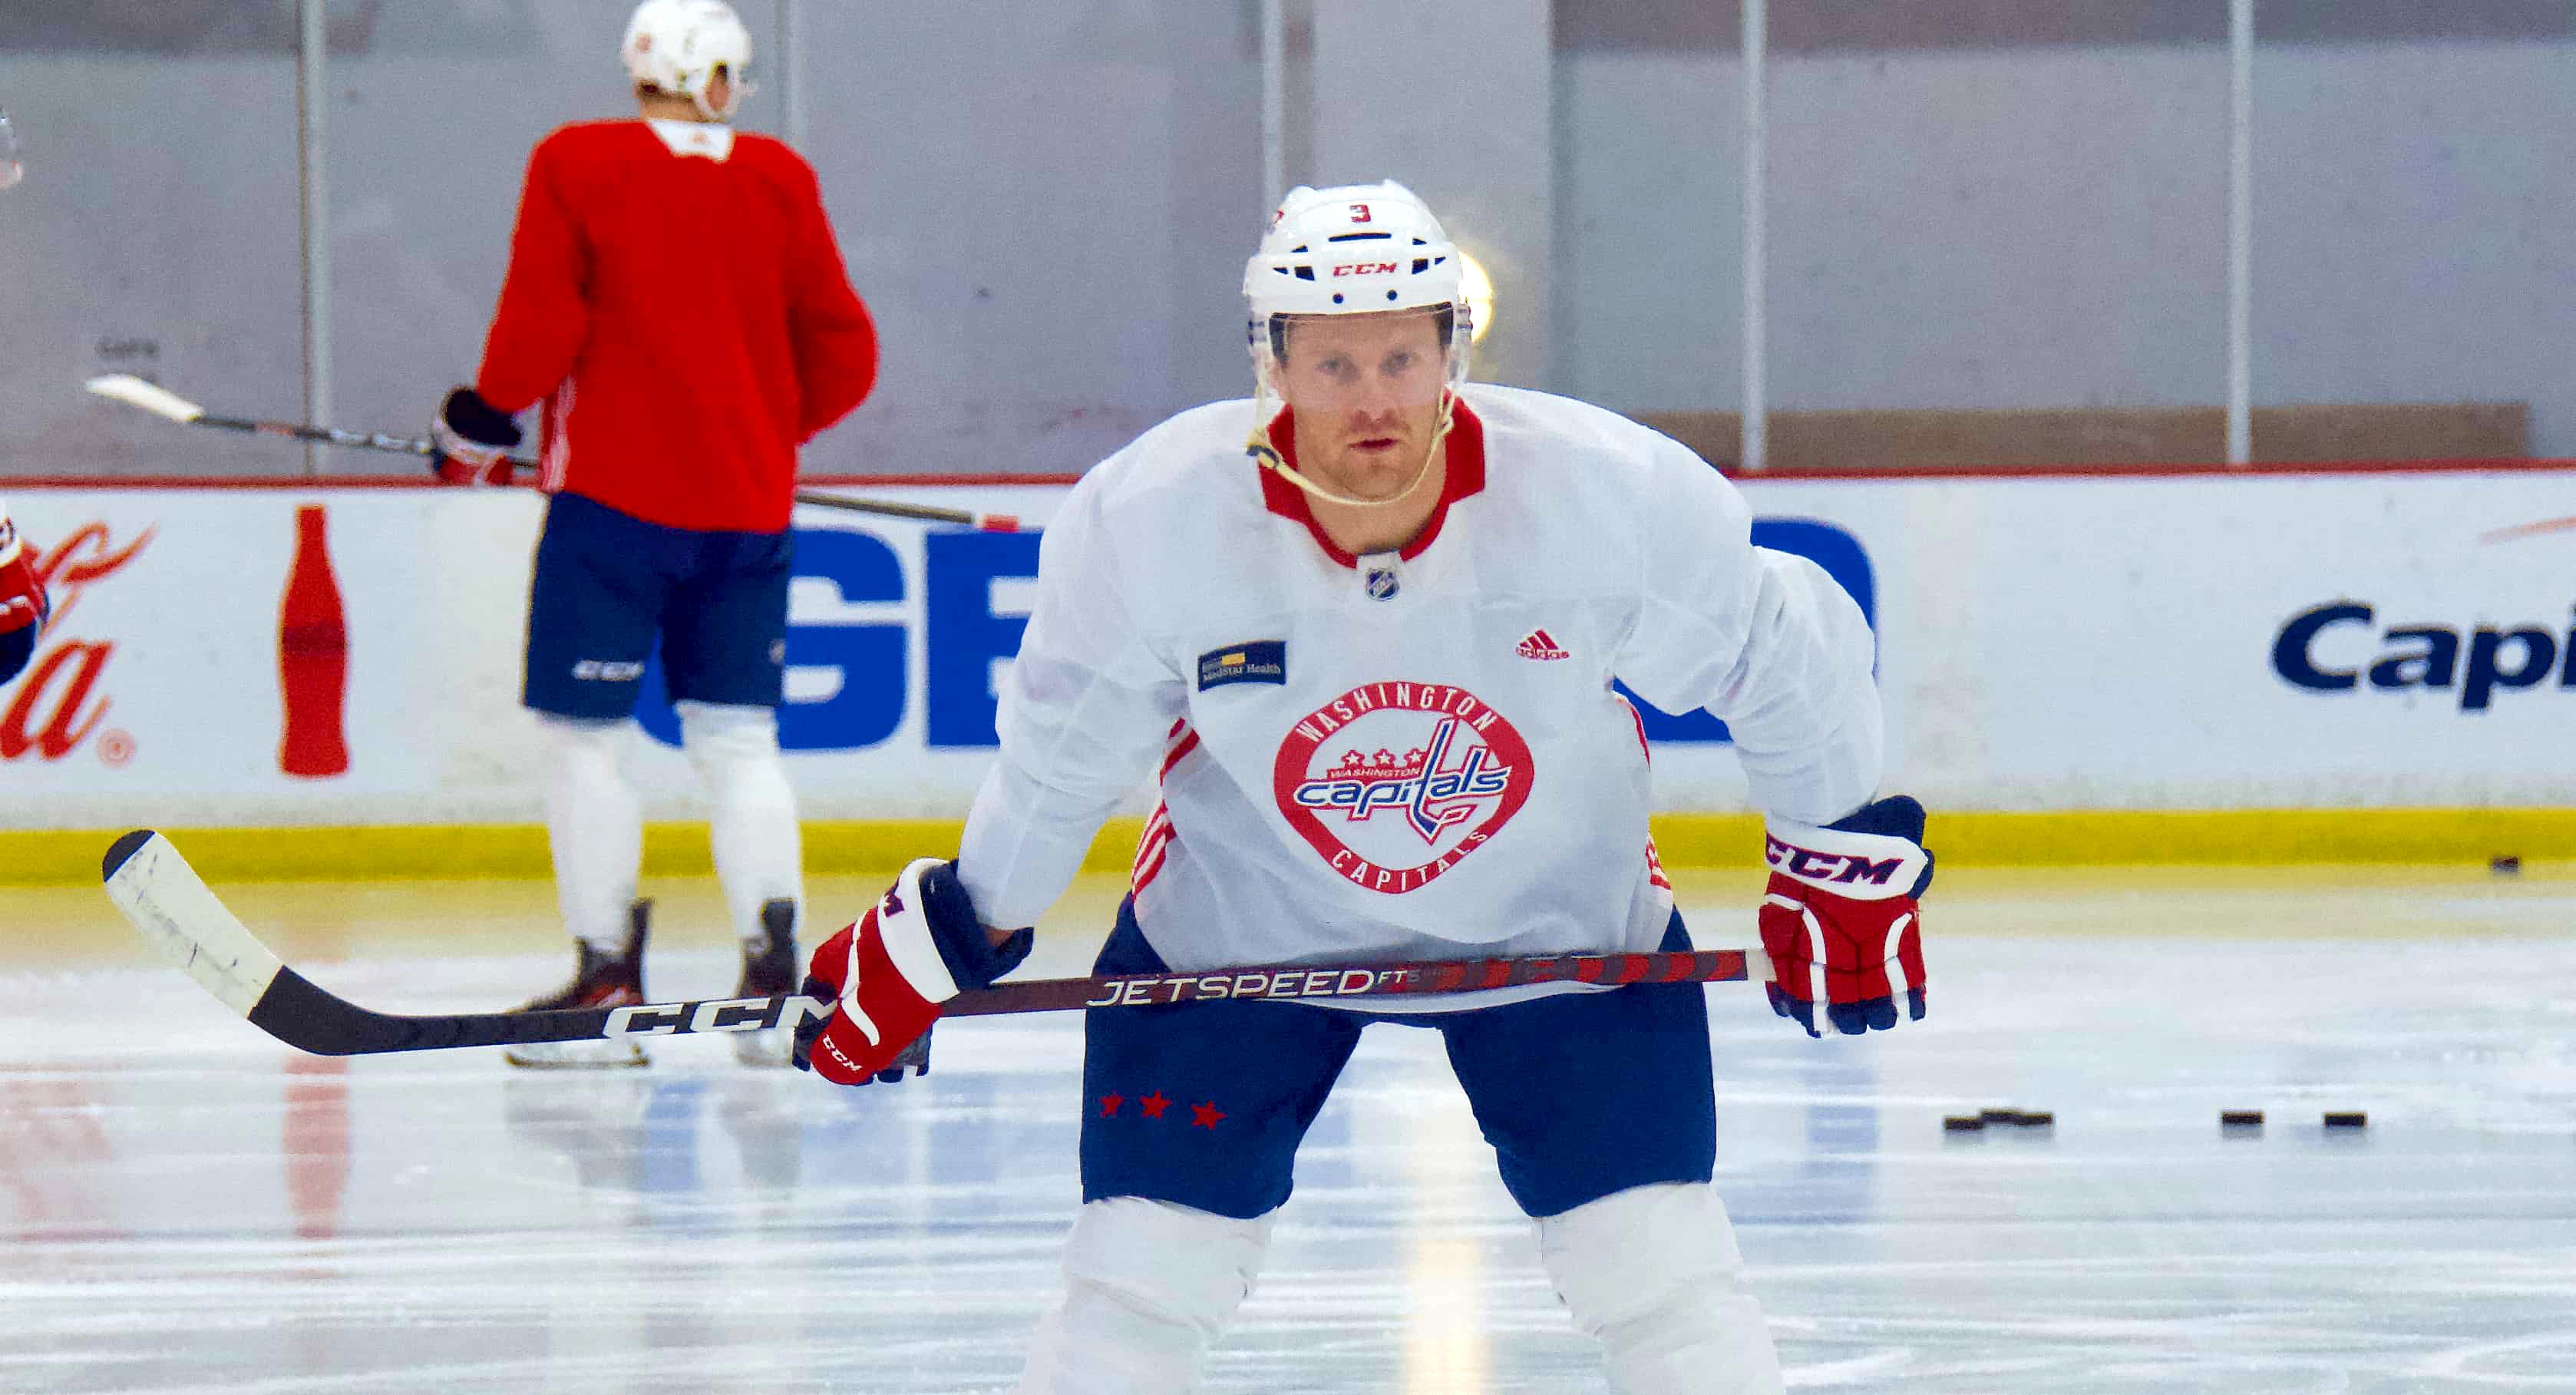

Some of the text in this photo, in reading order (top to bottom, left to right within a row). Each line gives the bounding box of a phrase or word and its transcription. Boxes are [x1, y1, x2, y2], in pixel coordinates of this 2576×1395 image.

[1349, 204, 1371, 223] 3
[1333, 263, 1397, 277] CCM
[1515, 646, 1570, 661] adidas
[1247, 663, 1282, 675] Health
[1295, 683, 1498, 742] WASHINGTON
[1293, 719, 1512, 840] capitals
[1329, 766, 1421, 778] WASHINGTON
[1332, 831, 1488, 891] CAPITALS
[1086, 970, 1375, 1007] JETSPEED
[822, 1033, 863, 1072] CCM
